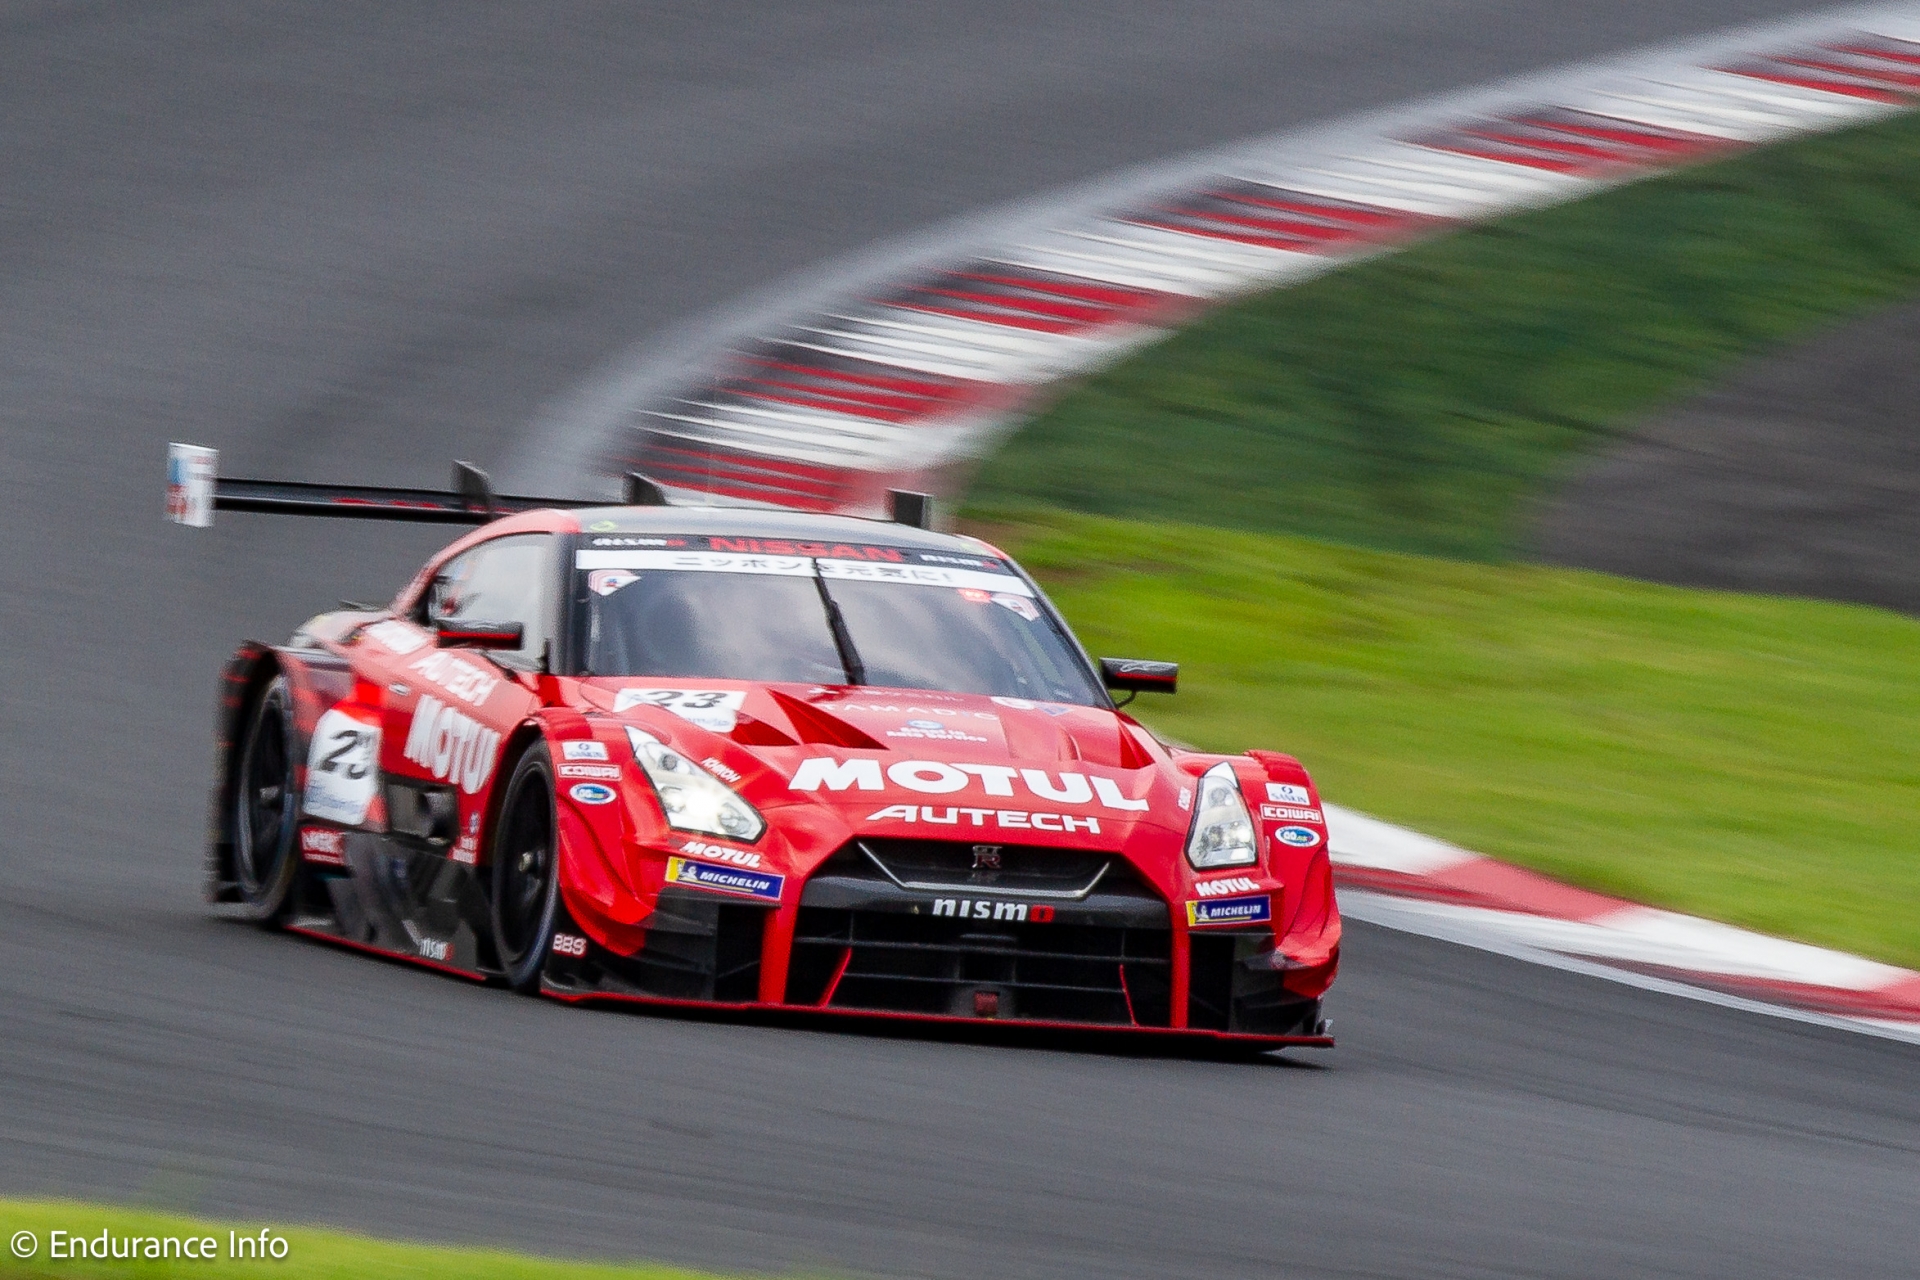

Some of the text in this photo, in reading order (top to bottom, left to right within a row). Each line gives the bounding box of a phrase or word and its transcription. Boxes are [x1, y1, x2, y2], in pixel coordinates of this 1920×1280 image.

[708, 537, 903, 562] NISSAN
[788, 757, 1150, 811] MOTUL
[866, 805, 1101, 834] AUTECH
[680, 841, 761, 868] MOTUL
[699, 872, 770, 890] MICHELIN
[1195, 877, 1260, 897] MOTUL
[932, 898, 1055, 922] nismo
[1211, 905, 1261, 917] MICHELIN
[553, 933, 586, 956] BBS
